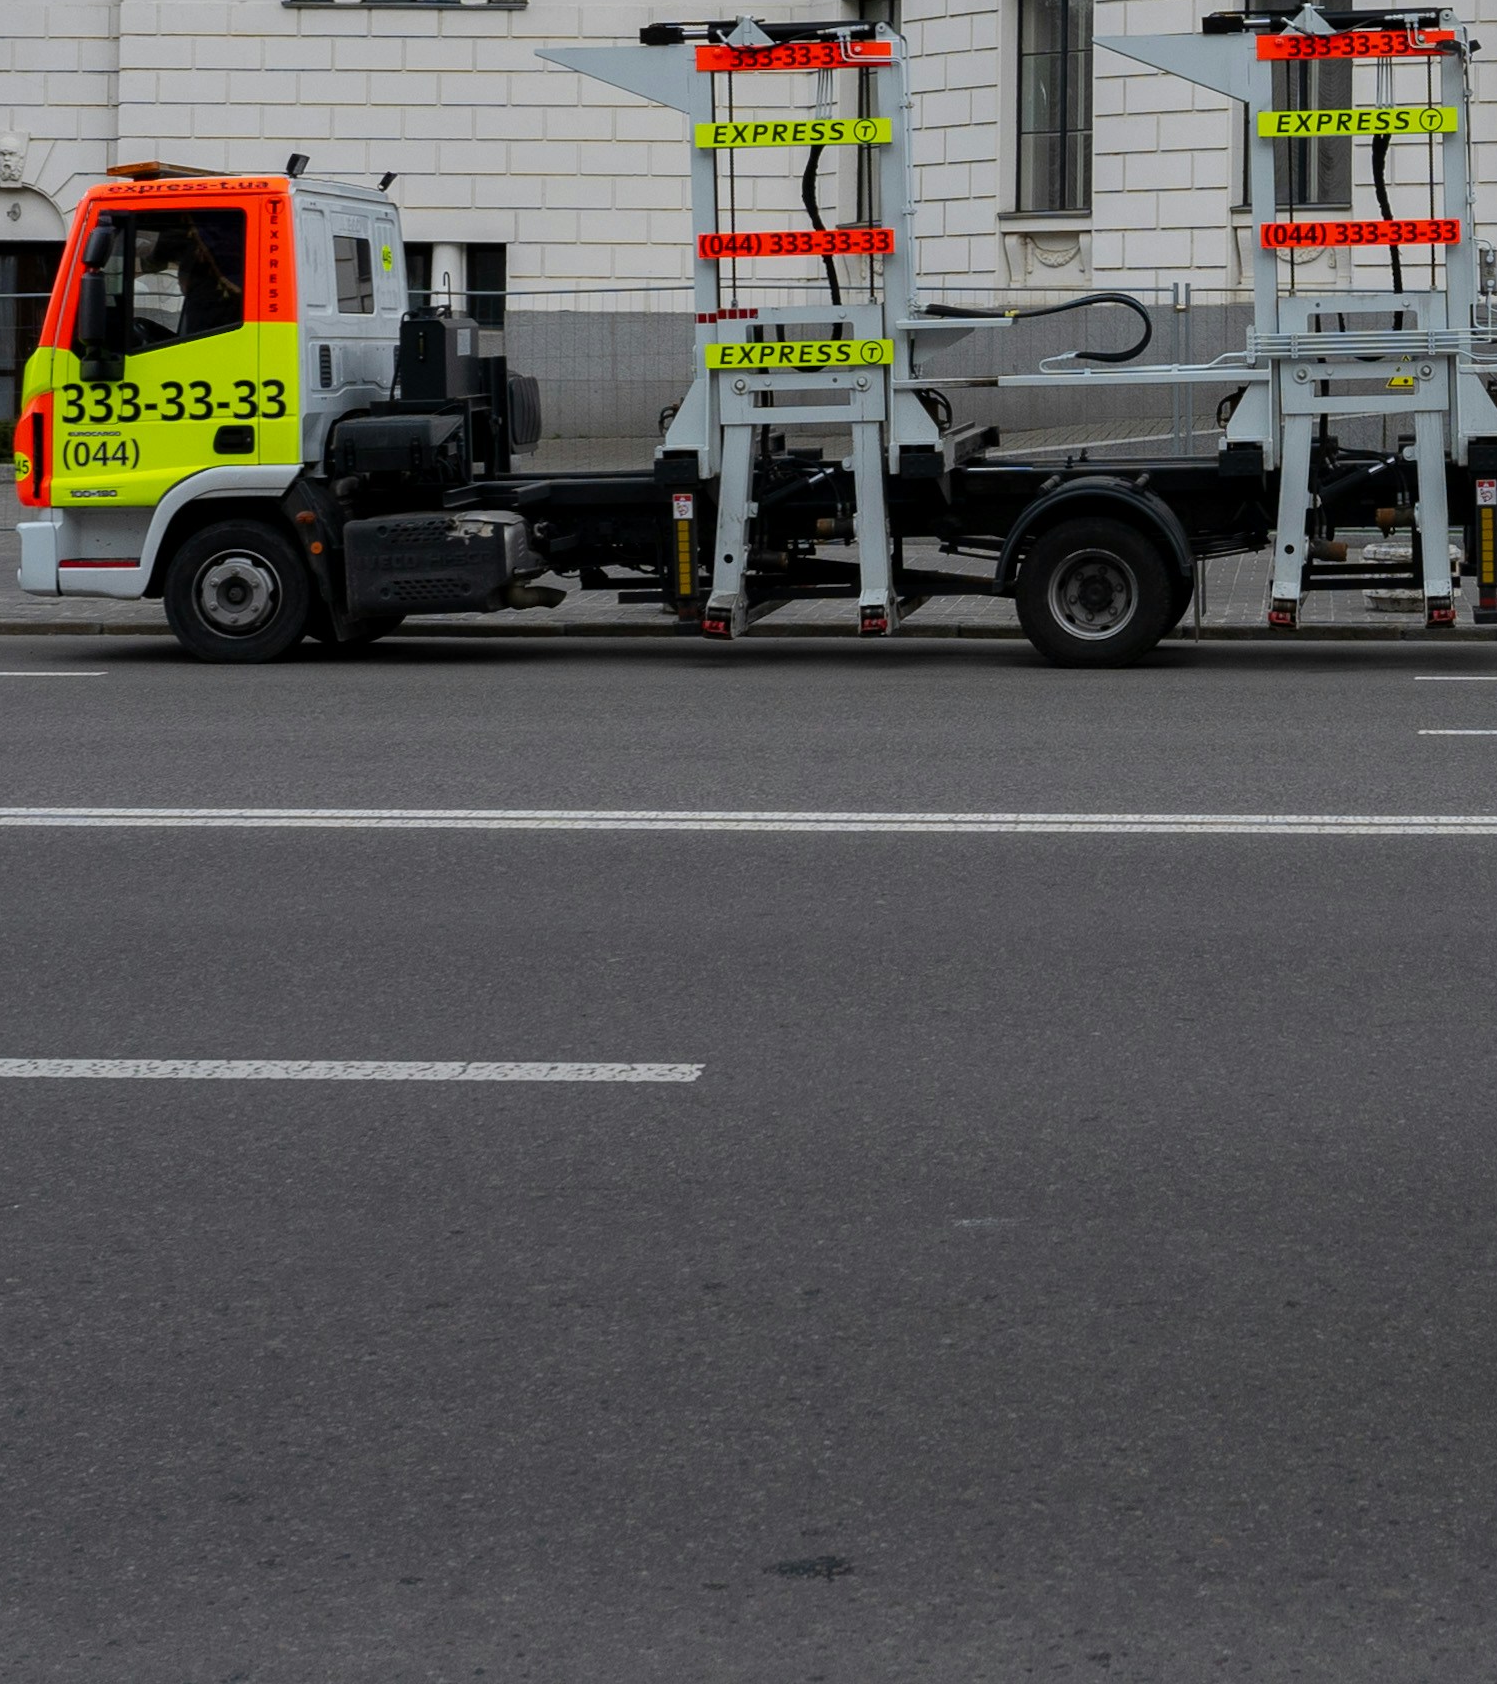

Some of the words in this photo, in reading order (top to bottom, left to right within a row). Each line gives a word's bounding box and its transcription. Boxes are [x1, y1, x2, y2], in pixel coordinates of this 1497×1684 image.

[713, 122, 845, 144] EXPRESS
[1276, 111, 1411, 133] EXPRESS
[107, 181, 269, 194] express-t.ua
[701, 233, 763, 255] (044)
[769, 232, 890, 253] 333-33-33
[1264, 223, 1327, 245] (044)
[1334, 221, 1457, 244] 333-33-33
[268, 215, 279, 313] EXPRESS
[720, 344, 851, 365] EXPRESS
[62, 379, 287, 424] 333-33-33
[62, 438, 140, 470] (044)
